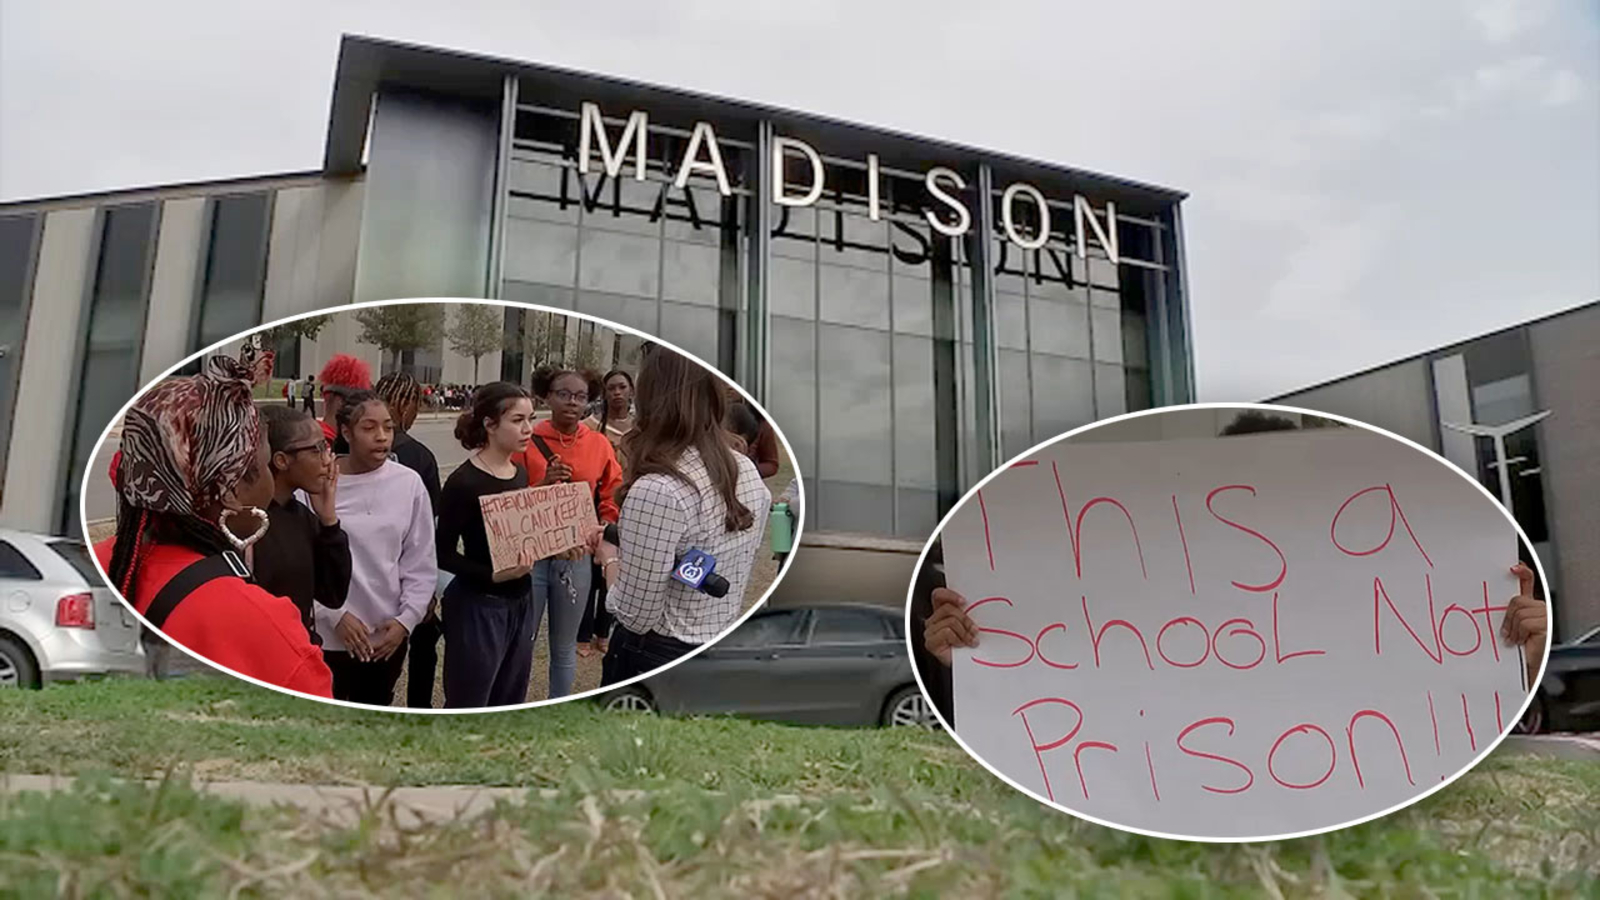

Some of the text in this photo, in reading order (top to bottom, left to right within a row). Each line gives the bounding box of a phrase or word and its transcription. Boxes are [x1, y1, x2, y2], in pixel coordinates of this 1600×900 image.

[577, 101, 1120, 264] MADISON
[553, 496, 580, 527] KEEP
[1330, 483, 1434, 568] a
[1373, 573, 1509, 664] Not
